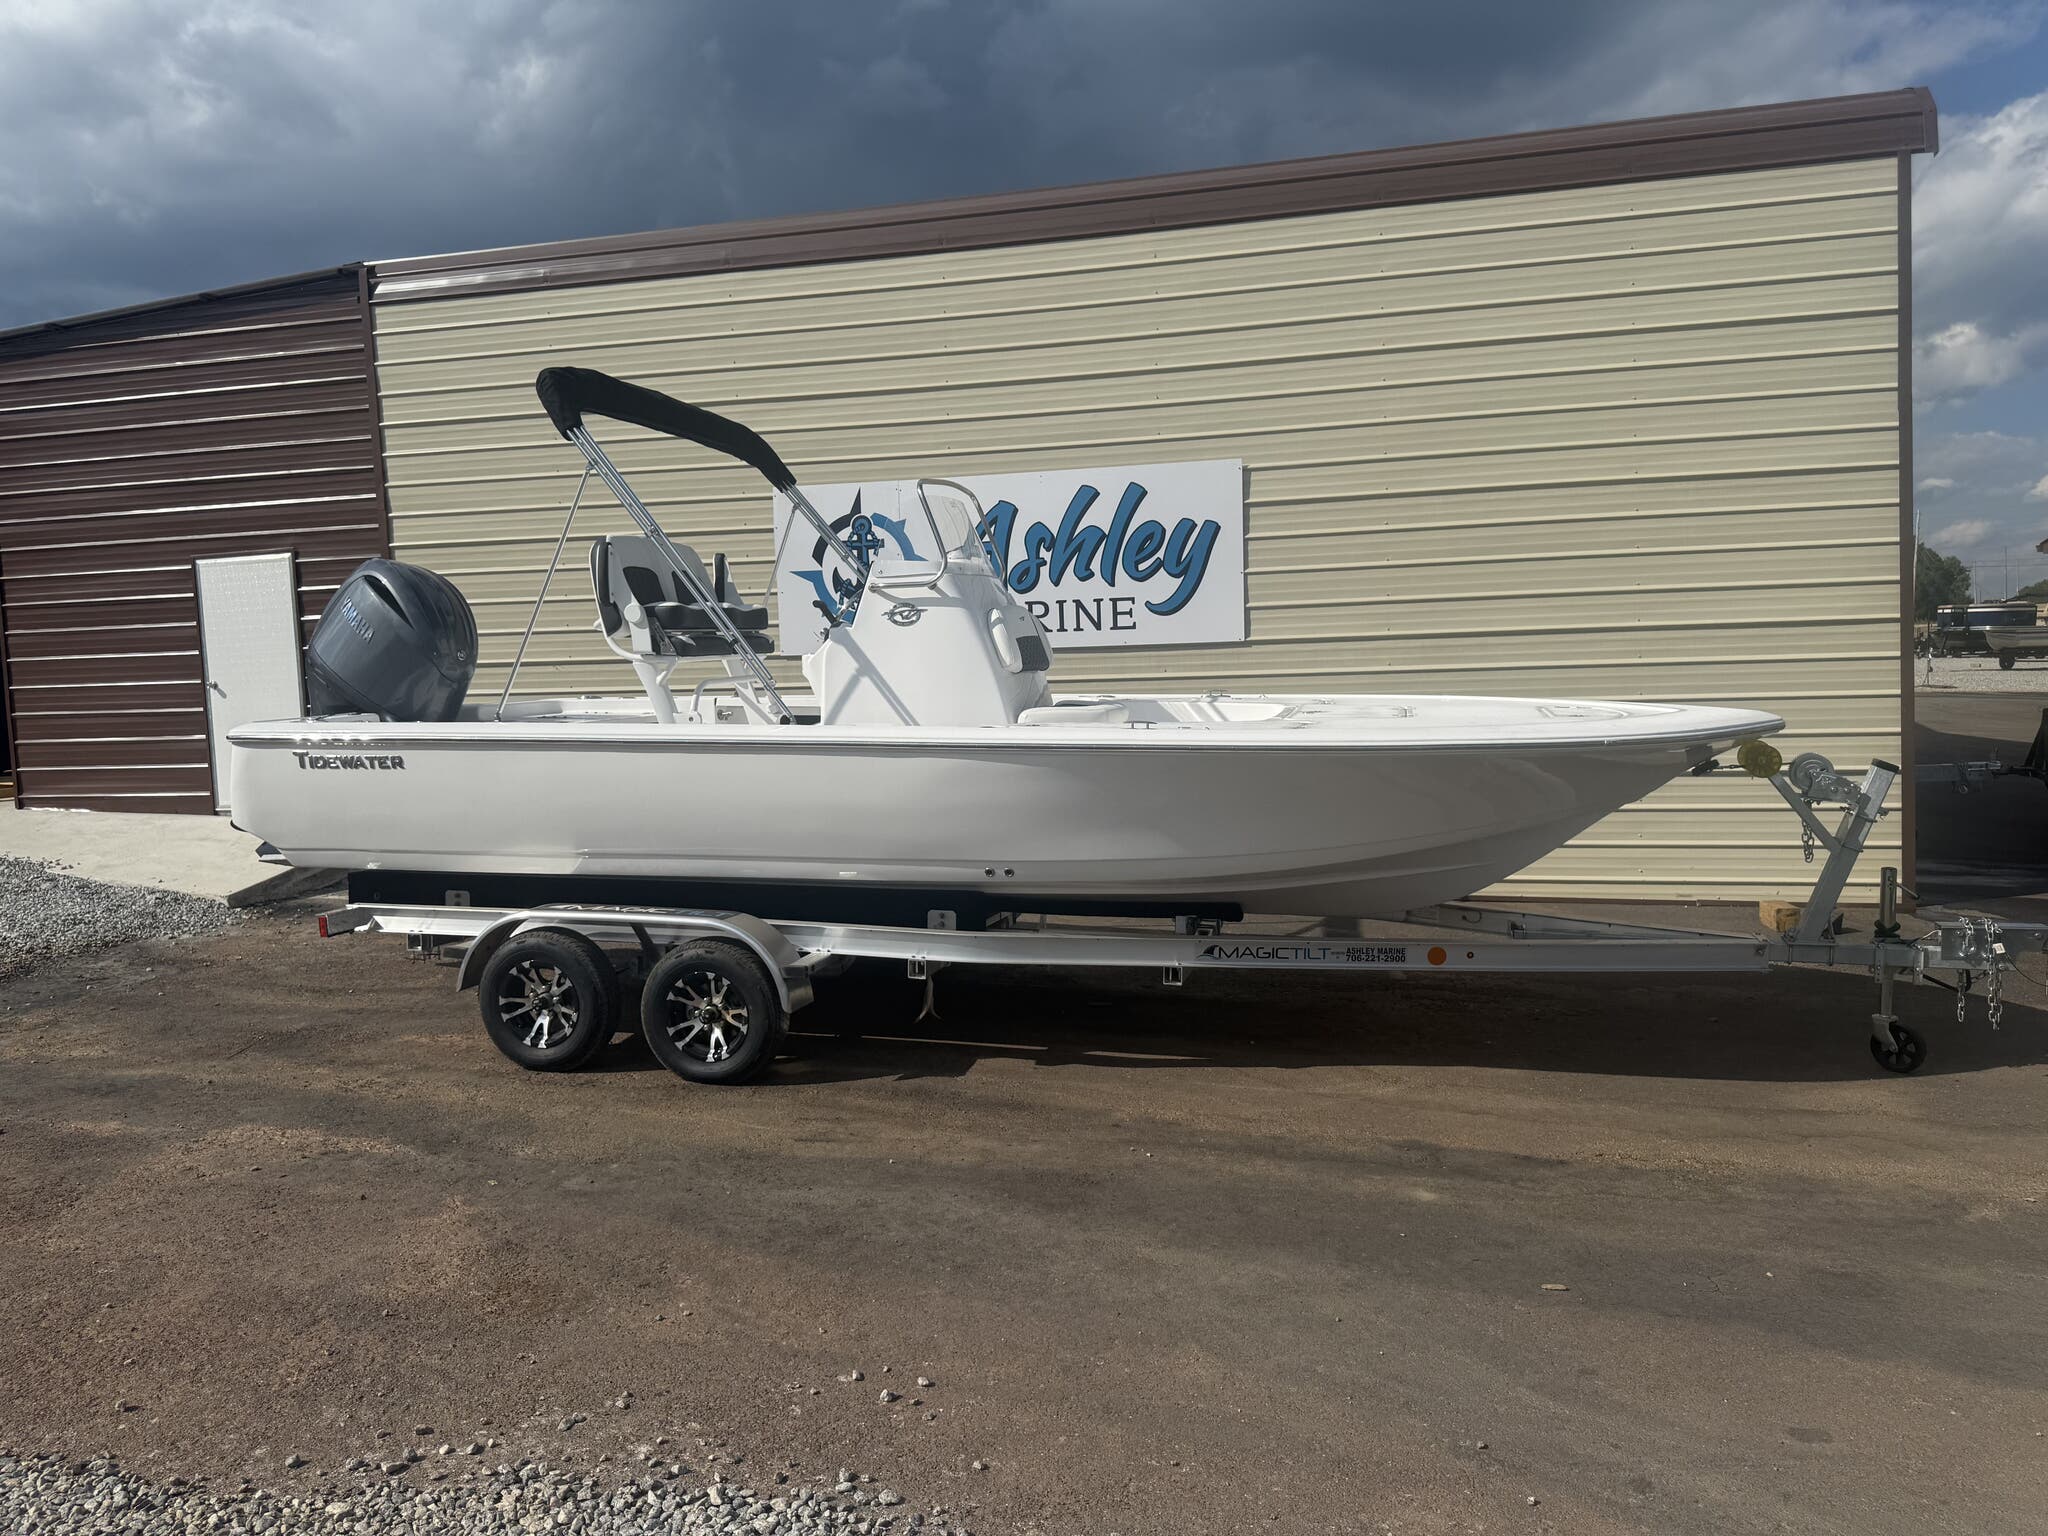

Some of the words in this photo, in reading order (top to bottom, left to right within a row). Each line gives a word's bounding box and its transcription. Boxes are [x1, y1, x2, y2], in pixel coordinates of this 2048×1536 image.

[973, 481, 1221, 616] Ashley
[340, 596, 376, 645] YAMAHA
[1025, 597, 1137, 633] RINE
[292, 750, 406, 770] TIDEWATER
[1218, 946, 1331, 960] MAGICTILT
[1346, 947, 1375, 955] ASHLEY
[1377, 947, 1406, 955] MARINE
